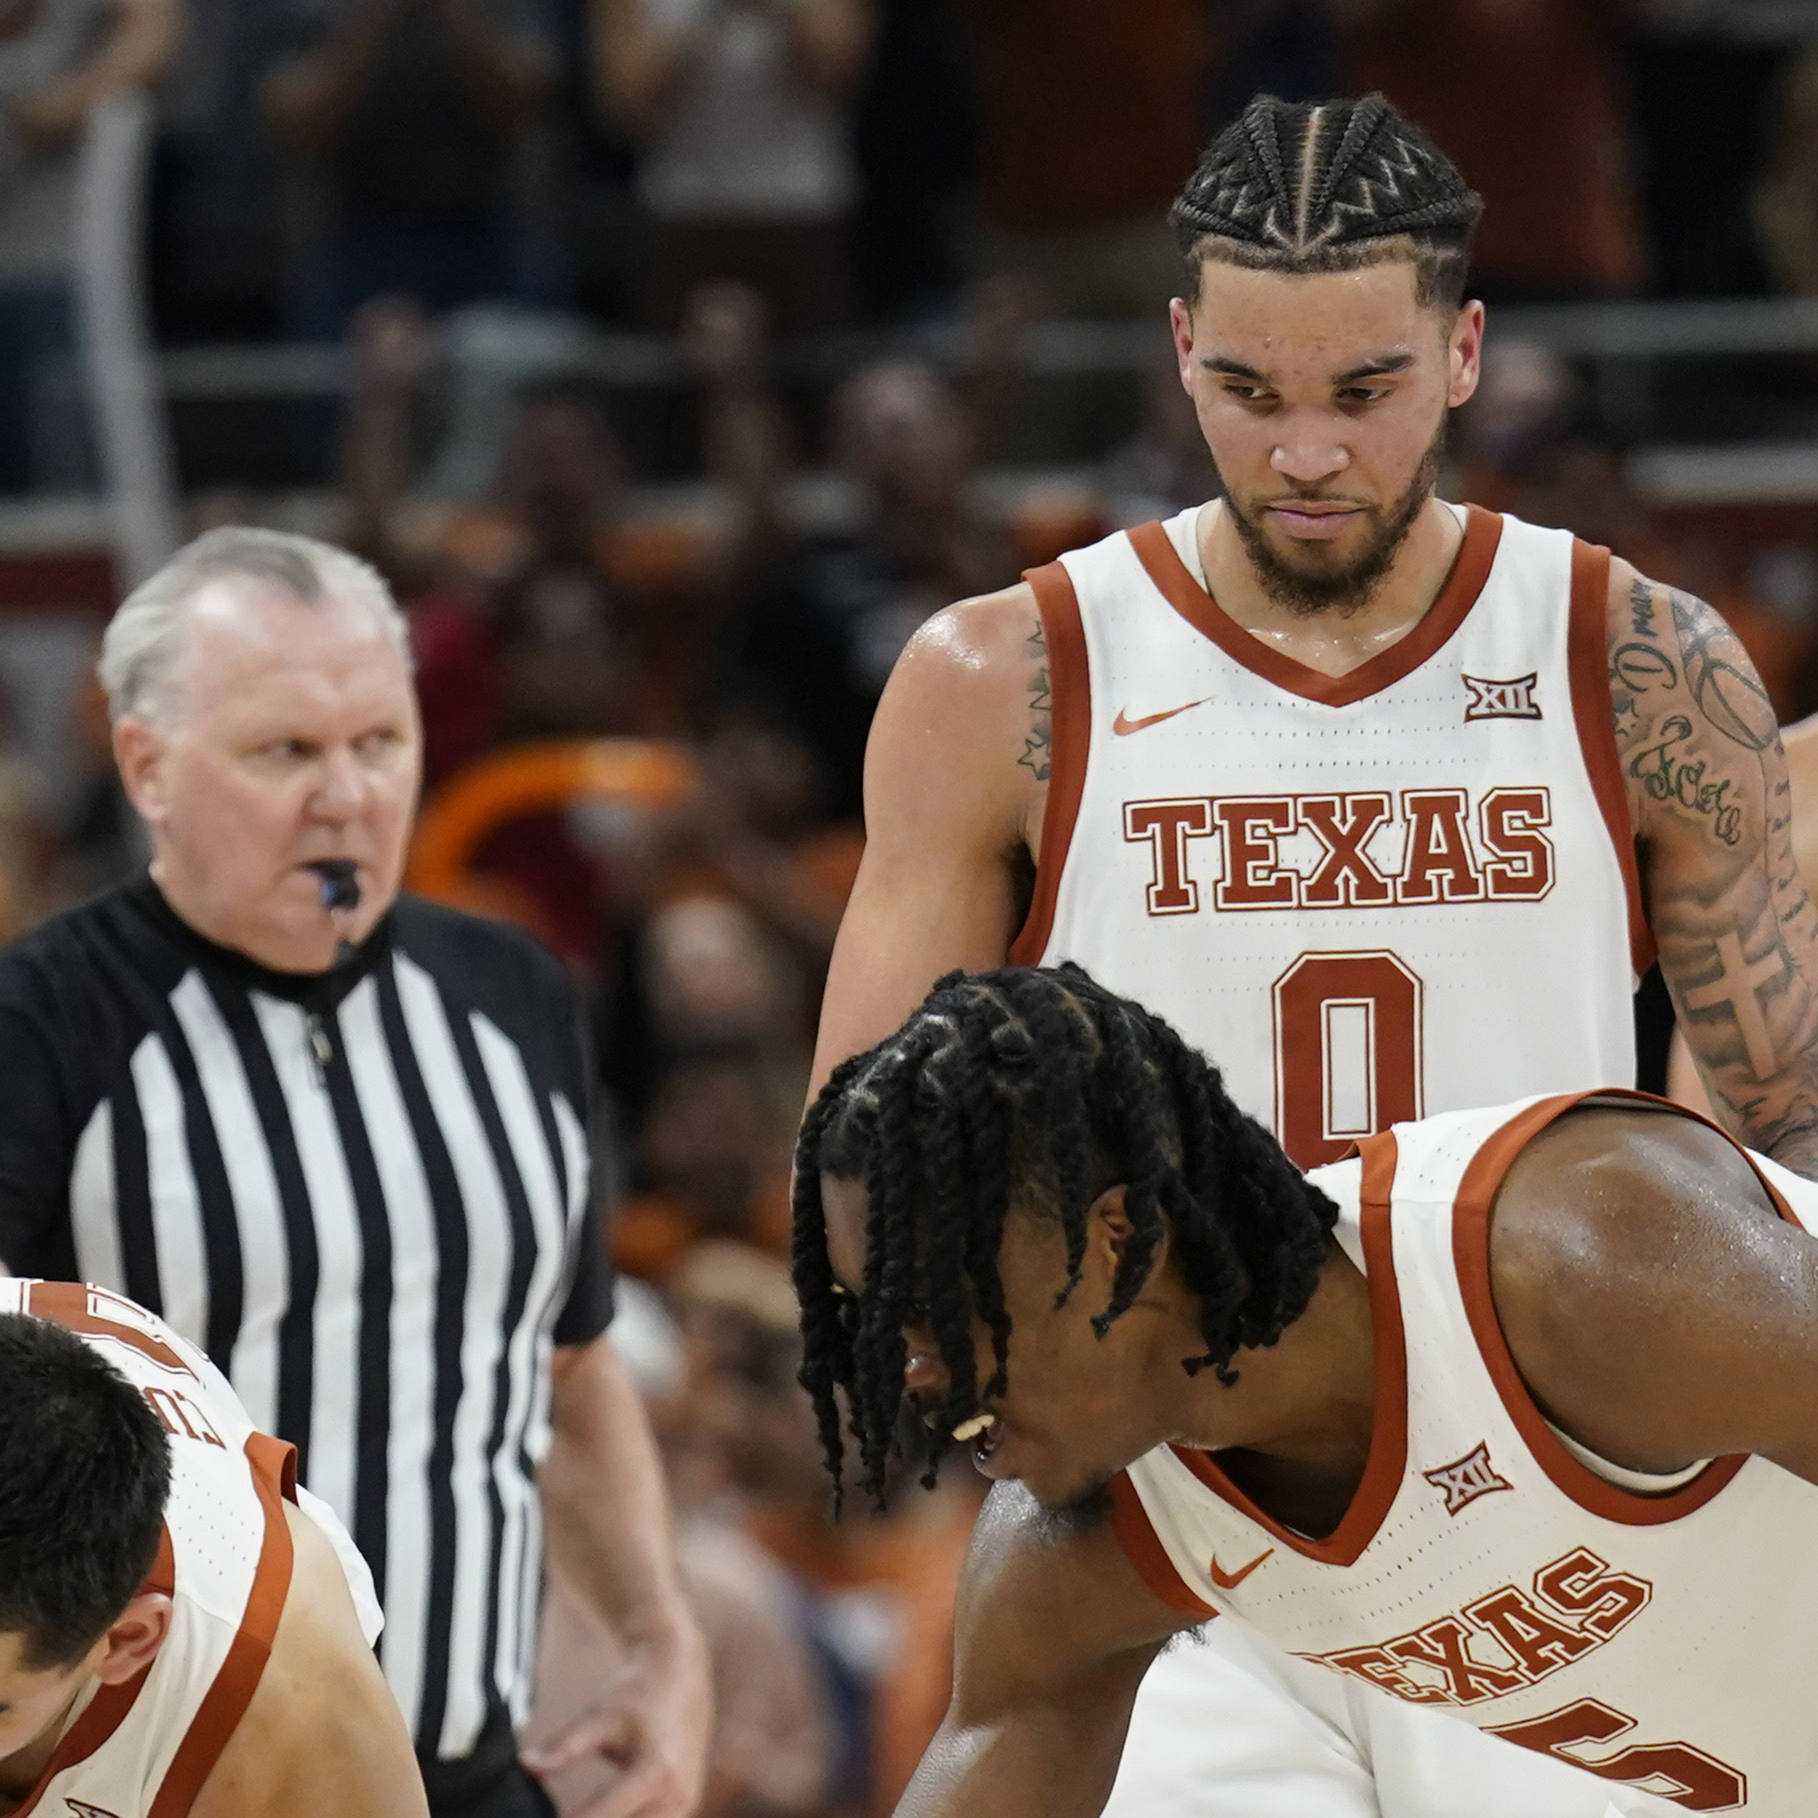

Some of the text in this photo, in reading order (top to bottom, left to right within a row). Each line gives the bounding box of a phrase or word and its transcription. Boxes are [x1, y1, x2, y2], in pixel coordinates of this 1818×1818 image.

[1122, 787, 1555, 916] TEXAS
[1271, 948, 1424, 1173] 0
[1285, 1546, 1653, 1707] EXAS
